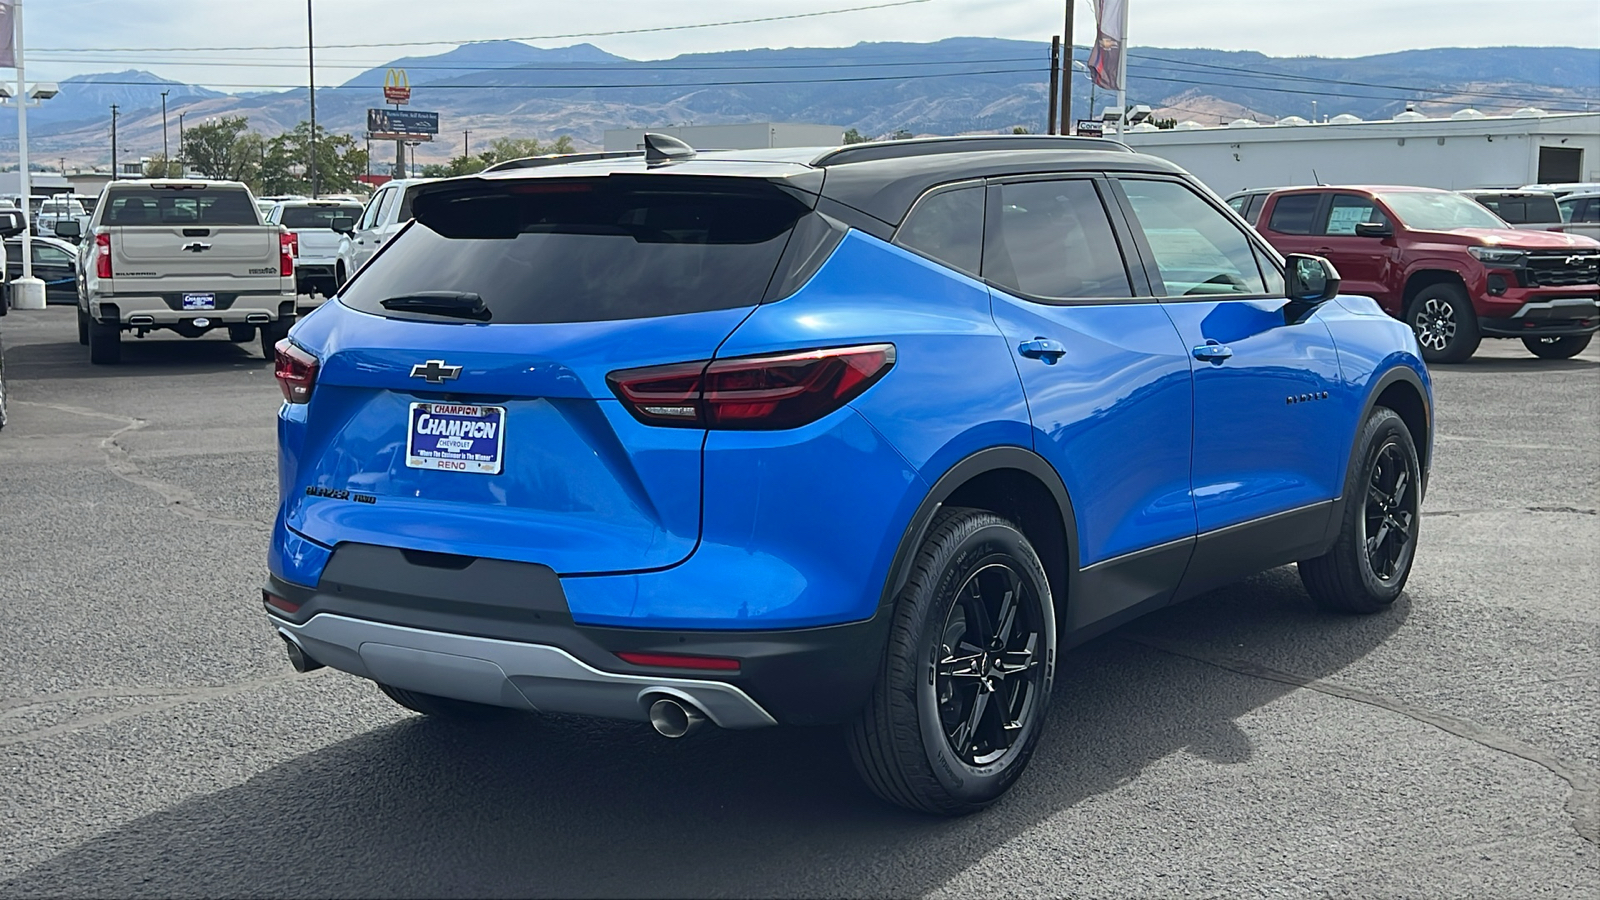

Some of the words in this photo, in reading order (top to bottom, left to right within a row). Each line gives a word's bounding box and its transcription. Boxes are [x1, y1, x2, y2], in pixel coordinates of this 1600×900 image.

[434, 404, 478, 416] CHAMPION
[417, 414, 496, 438] CHAMPION
[439, 440, 471, 448] CHEVROLET
[437, 460, 466, 470] RENO
[306, 486, 350, 501] BLAZER
